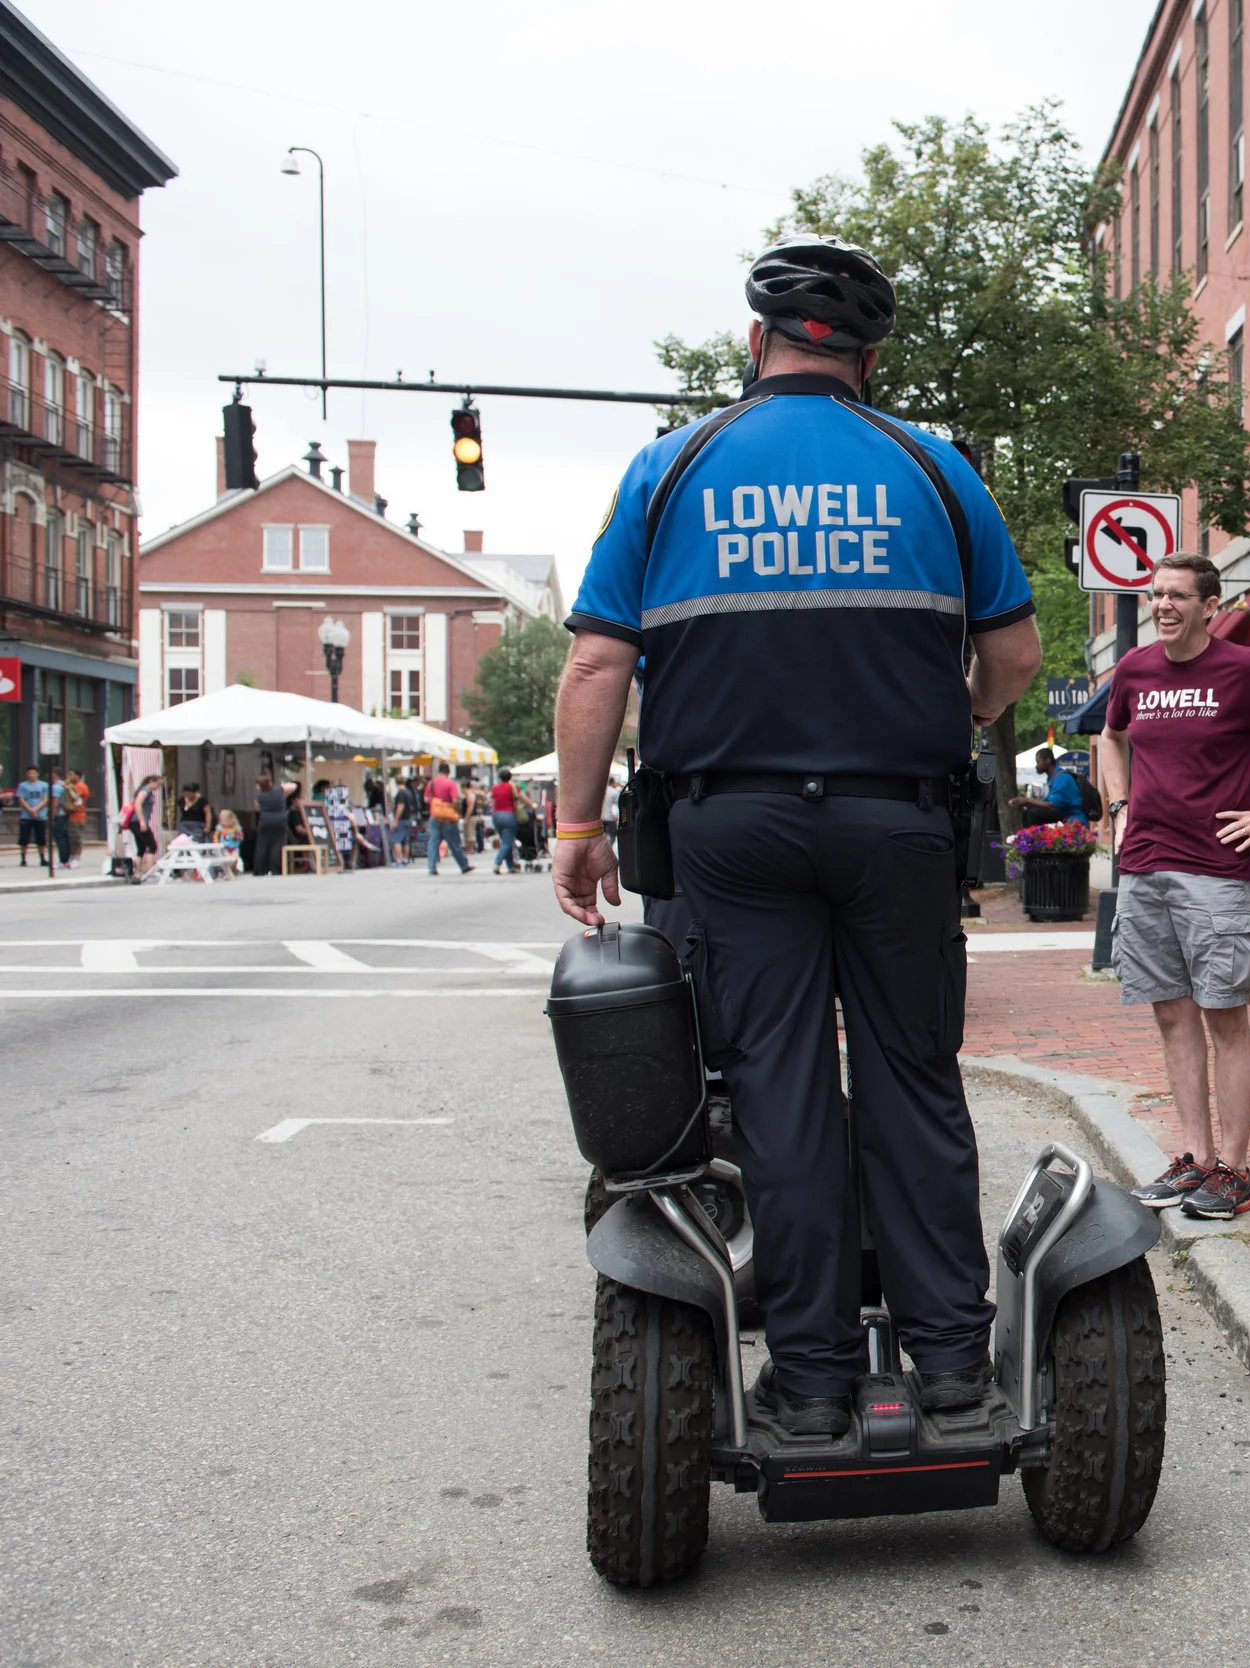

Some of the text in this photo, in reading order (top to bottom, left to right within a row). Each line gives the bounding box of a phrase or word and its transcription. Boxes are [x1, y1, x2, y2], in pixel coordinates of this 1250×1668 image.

[703, 484, 901, 532] LOWELL
[717, 530, 890, 578] POLICE
[1048, 690, 1066, 705] ALL
[1137, 688, 1219, 710] LOWELL
[1136, 707, 1218, 720] there's a lot to like
